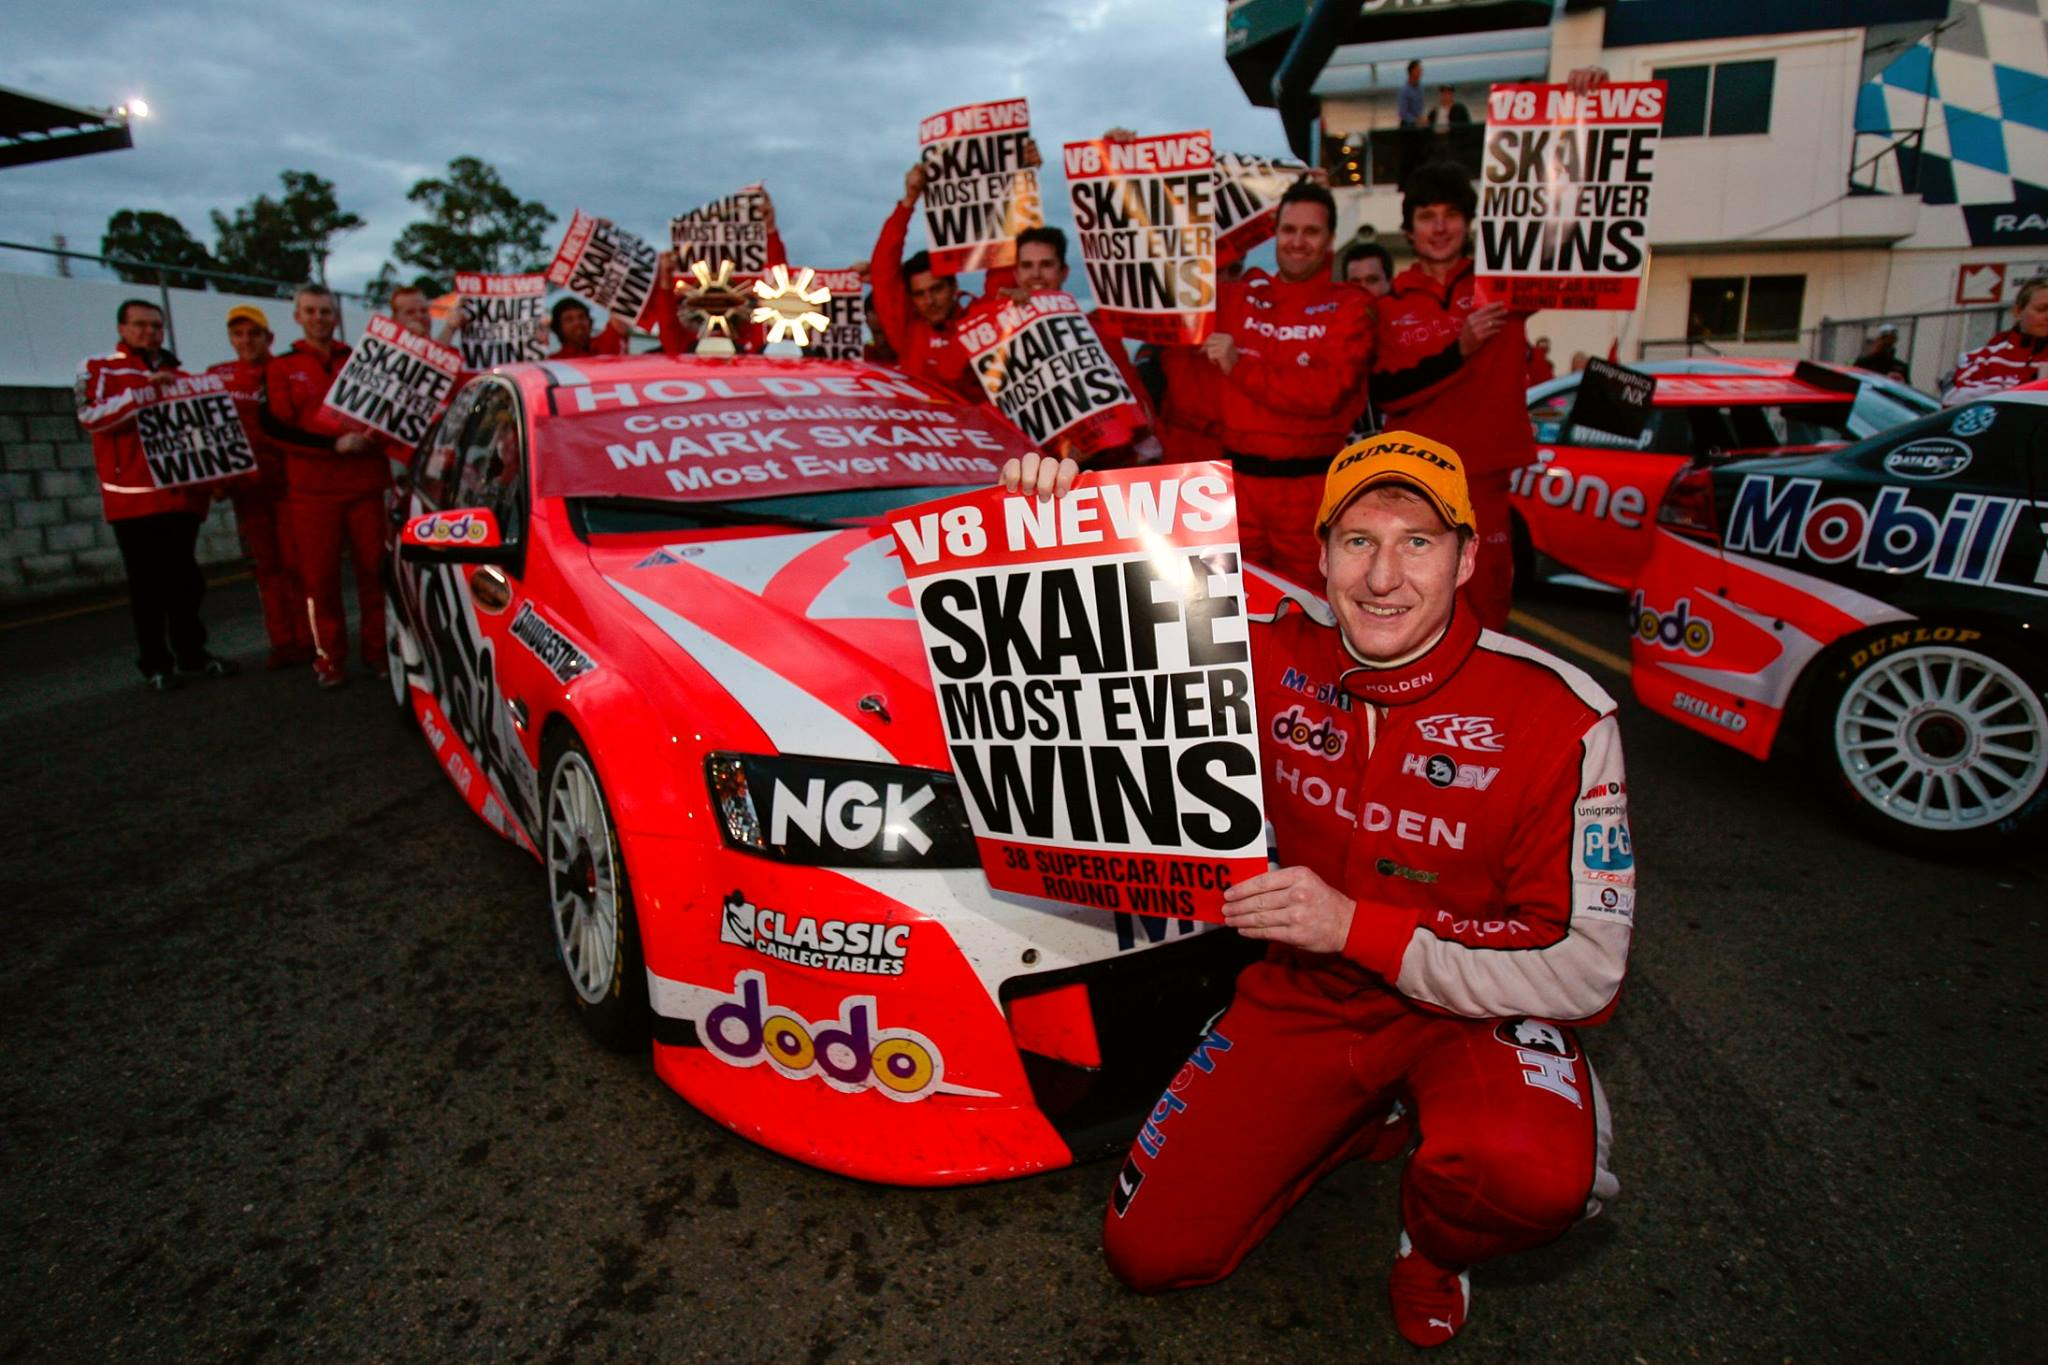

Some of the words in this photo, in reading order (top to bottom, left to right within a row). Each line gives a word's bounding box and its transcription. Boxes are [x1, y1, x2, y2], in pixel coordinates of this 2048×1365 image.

[921, 116, 947, 142] V8
[952, 101, 1028, 132] NEWS
[1490, 90, 1536, 121] V8
[1546, 87, 1663, 120] NEWS
[1064, 145, 1101, 175] V8
[1109, 135, 1211, 170] NEWS
[1486, 127, 1660, 183] SKAIFE
[925, 178, 979, 208] MOST
[988, 170, 1038, 199] EVER
[1071, 172, 1212, 231] SKAIFE
[1483, 185, 1563, 217] MOST
[1575, 185, 1649, 217] EVER
[1080, 230, 1138, 260] MOST
[1147, 226, 1212, 258] EVER
[1481, 219, 1645, 272] WINS
[1994, 213, 2048, 232] RA
[610, 239, 657, 319] WINS
[1086, 258, 1215, 310] WINS
[462, 297, 542, 323] SKAIFE
[958, 321, 998, 352] V8
[996, 294, 1076, 332] NEWS
[356, 338, 451, 401] SKAIFE
[462, 338, 545, 368] WINS
[977, 314, 1097, 393] SKAIFE
[575, 376, 931, 412] HOLDEN
[996, 366, 1047, 414] MOST
[1050, 345, 1106, 381] EVER
[139, 394, 239, 437] SKAIFE
[333, 378, 427, 442] WINS
[624, 403, 956, 434] Congratulations
[148, 441, 254, 485] WINS
[606, 428, 801, 470] MARK
[809, 424, 1004, 451] SKAIFE
[1334, 442, 1457, 474] DUNLOP
[664, 462, 787, 493] Most
[800, 453, 892, 477] Ever
[896, 451, 998, 474] Wins
[416, 517, 486, 543] dodo
[892, 505, 988, 566] V8
[1003, 476, 1237, 552] NEWS
[1725, 474, 2016, 587] Mobil
[919, 551, 1249, 681] SKAIFE
[1851, 627, 1981, 669] DUNLOP
[940, 678, 1083, 741] MOST
[1098, 668, 1253, 741] EVER
[1366, 672, 1433, 694] HOLDEN
[1273, 708, 1346, 756] dodo
[1674, 692, 1747, 732] SKILLED
[771, 777, 937, 856] NGK
[949, 740, 1263, 851] WINS
[1276, 759, 1467, 850] HOLDEN
[1003, 845, 1030, 871] 38
[1037, 850, 1232, 891] SUPERCAR/ATCC
[1043, 876, 1120, 910] ROUND
[1126, 886, 1196, 918] WINS
[755, 909, 911, 957] CLASSIC
[755, 937, 905, 976] CARLECTABLES
[705, 978, 934, 1094] dodo
[1137, 1029, 1234, 1160] Mobil
